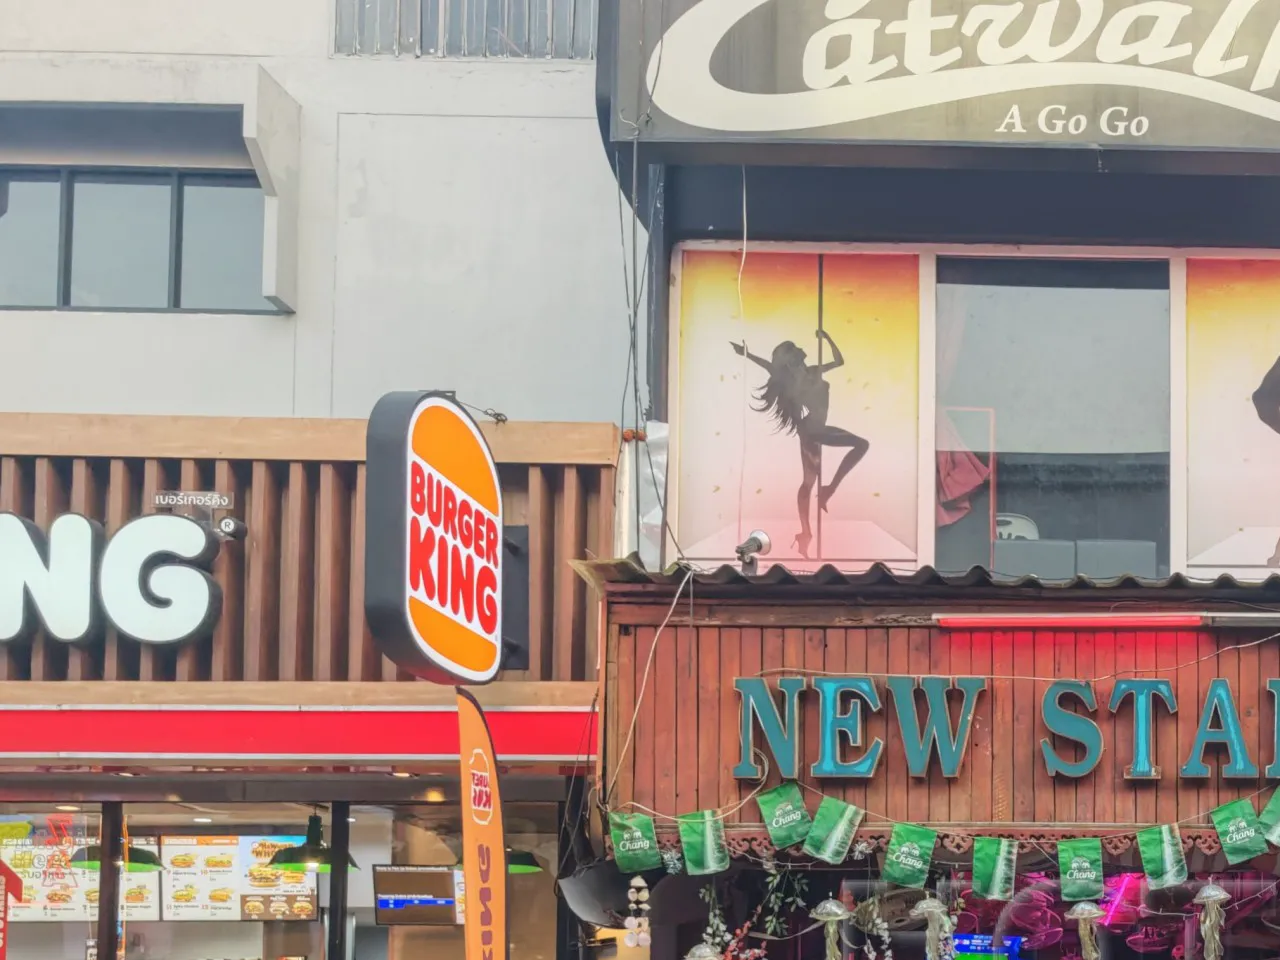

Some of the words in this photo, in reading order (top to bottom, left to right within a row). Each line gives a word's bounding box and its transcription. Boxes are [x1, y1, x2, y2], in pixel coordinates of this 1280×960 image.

[995, 105, 1027, 135] A
[1038, 105, 1086, 136] Go
[1099, 106, 1150, 138] Go
[410, 459, 500, 570] BURGER
[409, 517, 500, 637] KING
[733, 676, 986, 780] NEW
[772, 811, 801, 828] Chang
[1226, 828, 1255, 843] Chang
[619, 840, 650, 851] Chang
[893, 852, 923, 869] Chang
[1066, 870, 1096, 880] Chang
